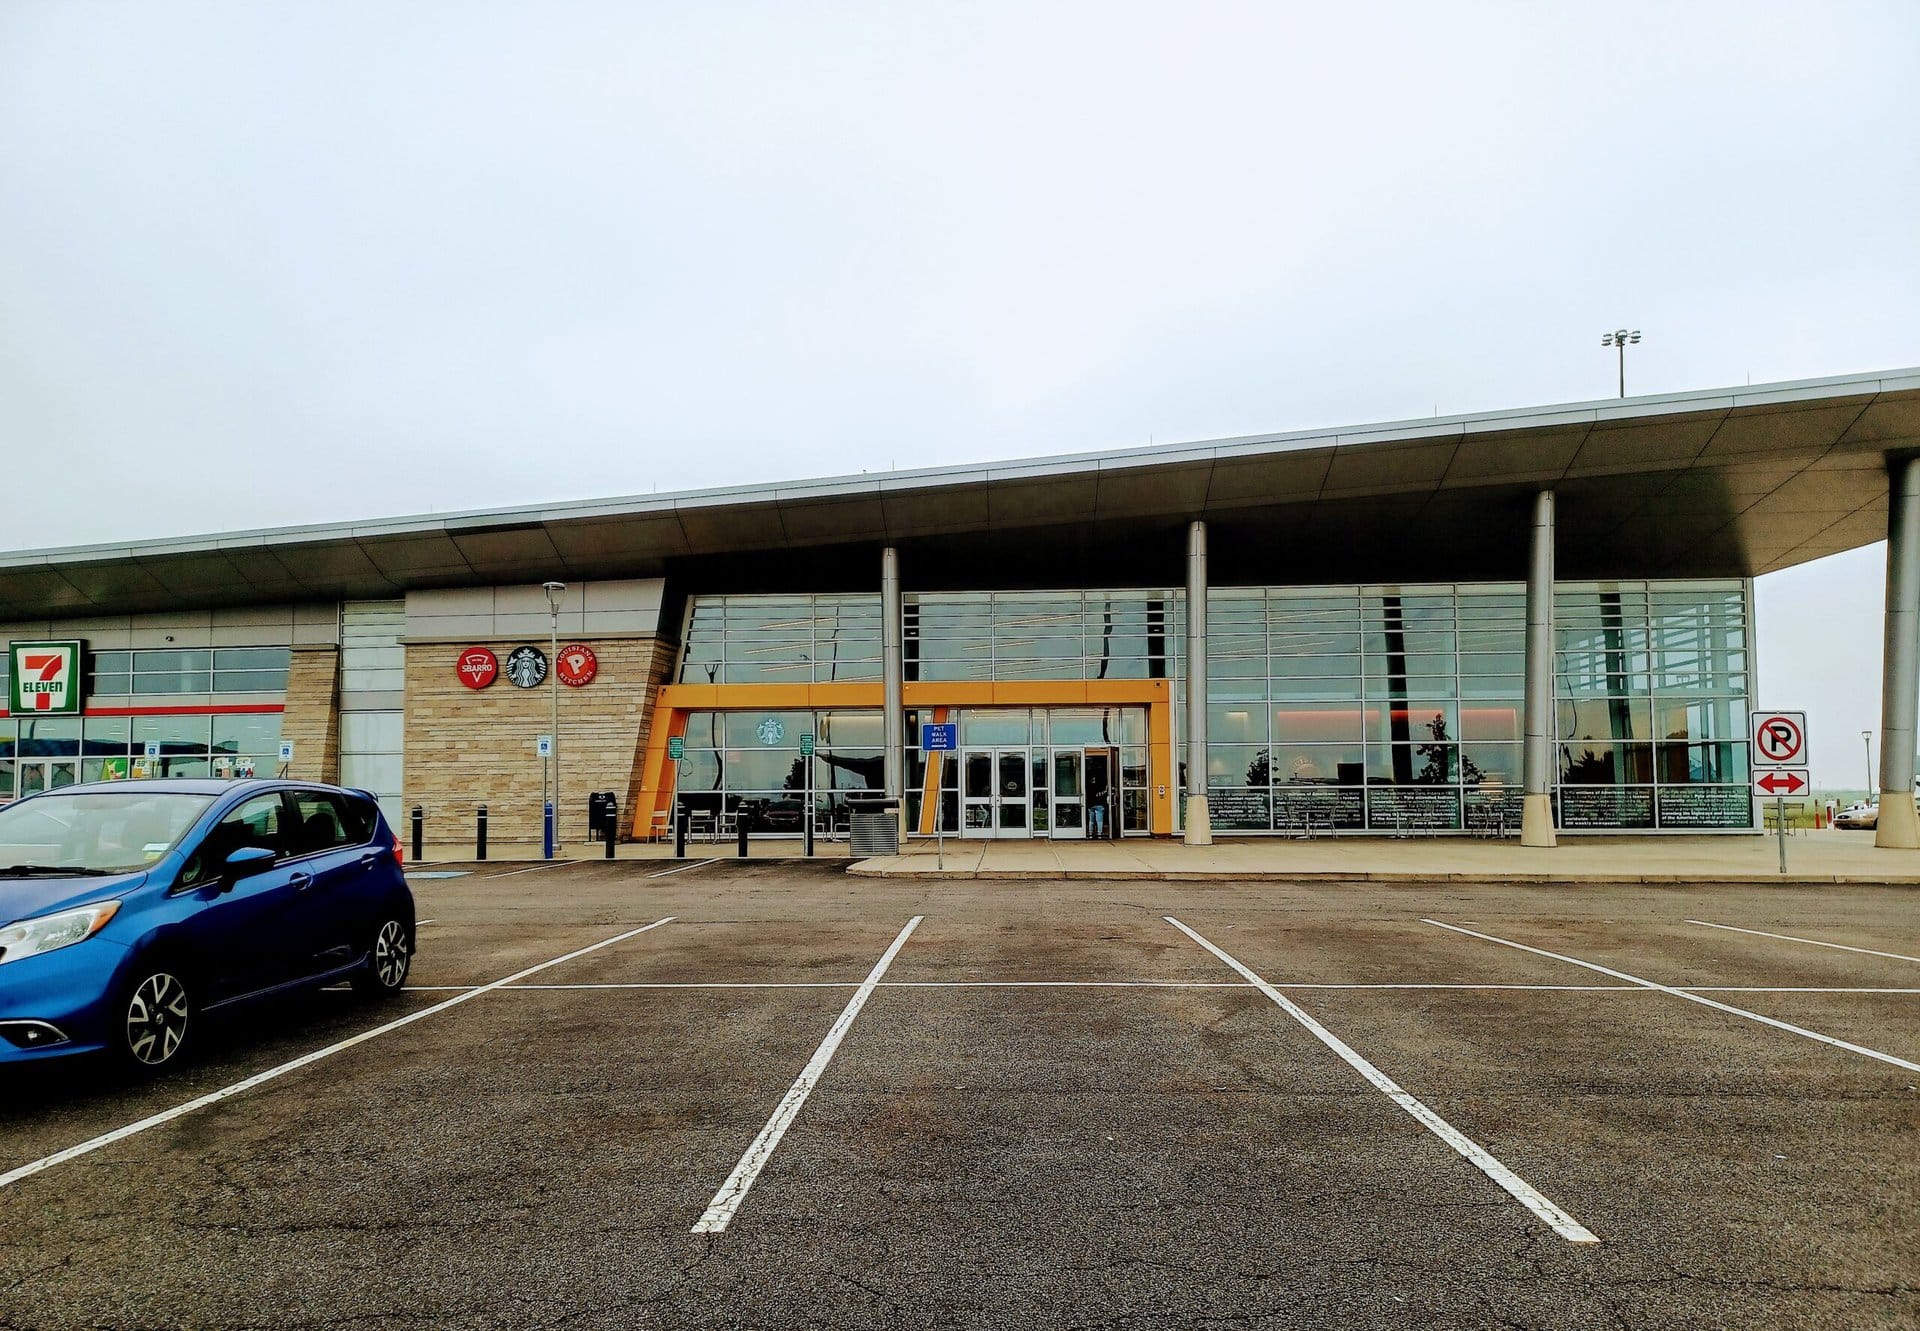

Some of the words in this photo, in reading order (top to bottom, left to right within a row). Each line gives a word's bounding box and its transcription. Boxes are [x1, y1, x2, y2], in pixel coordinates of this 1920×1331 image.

[558, 645, 593, 663] LOUISIANA
[462, 664, 493, 673] SBARRO
[25, 654, 62, 710] 7
[560, 670, 593, 685] KITCHEN
